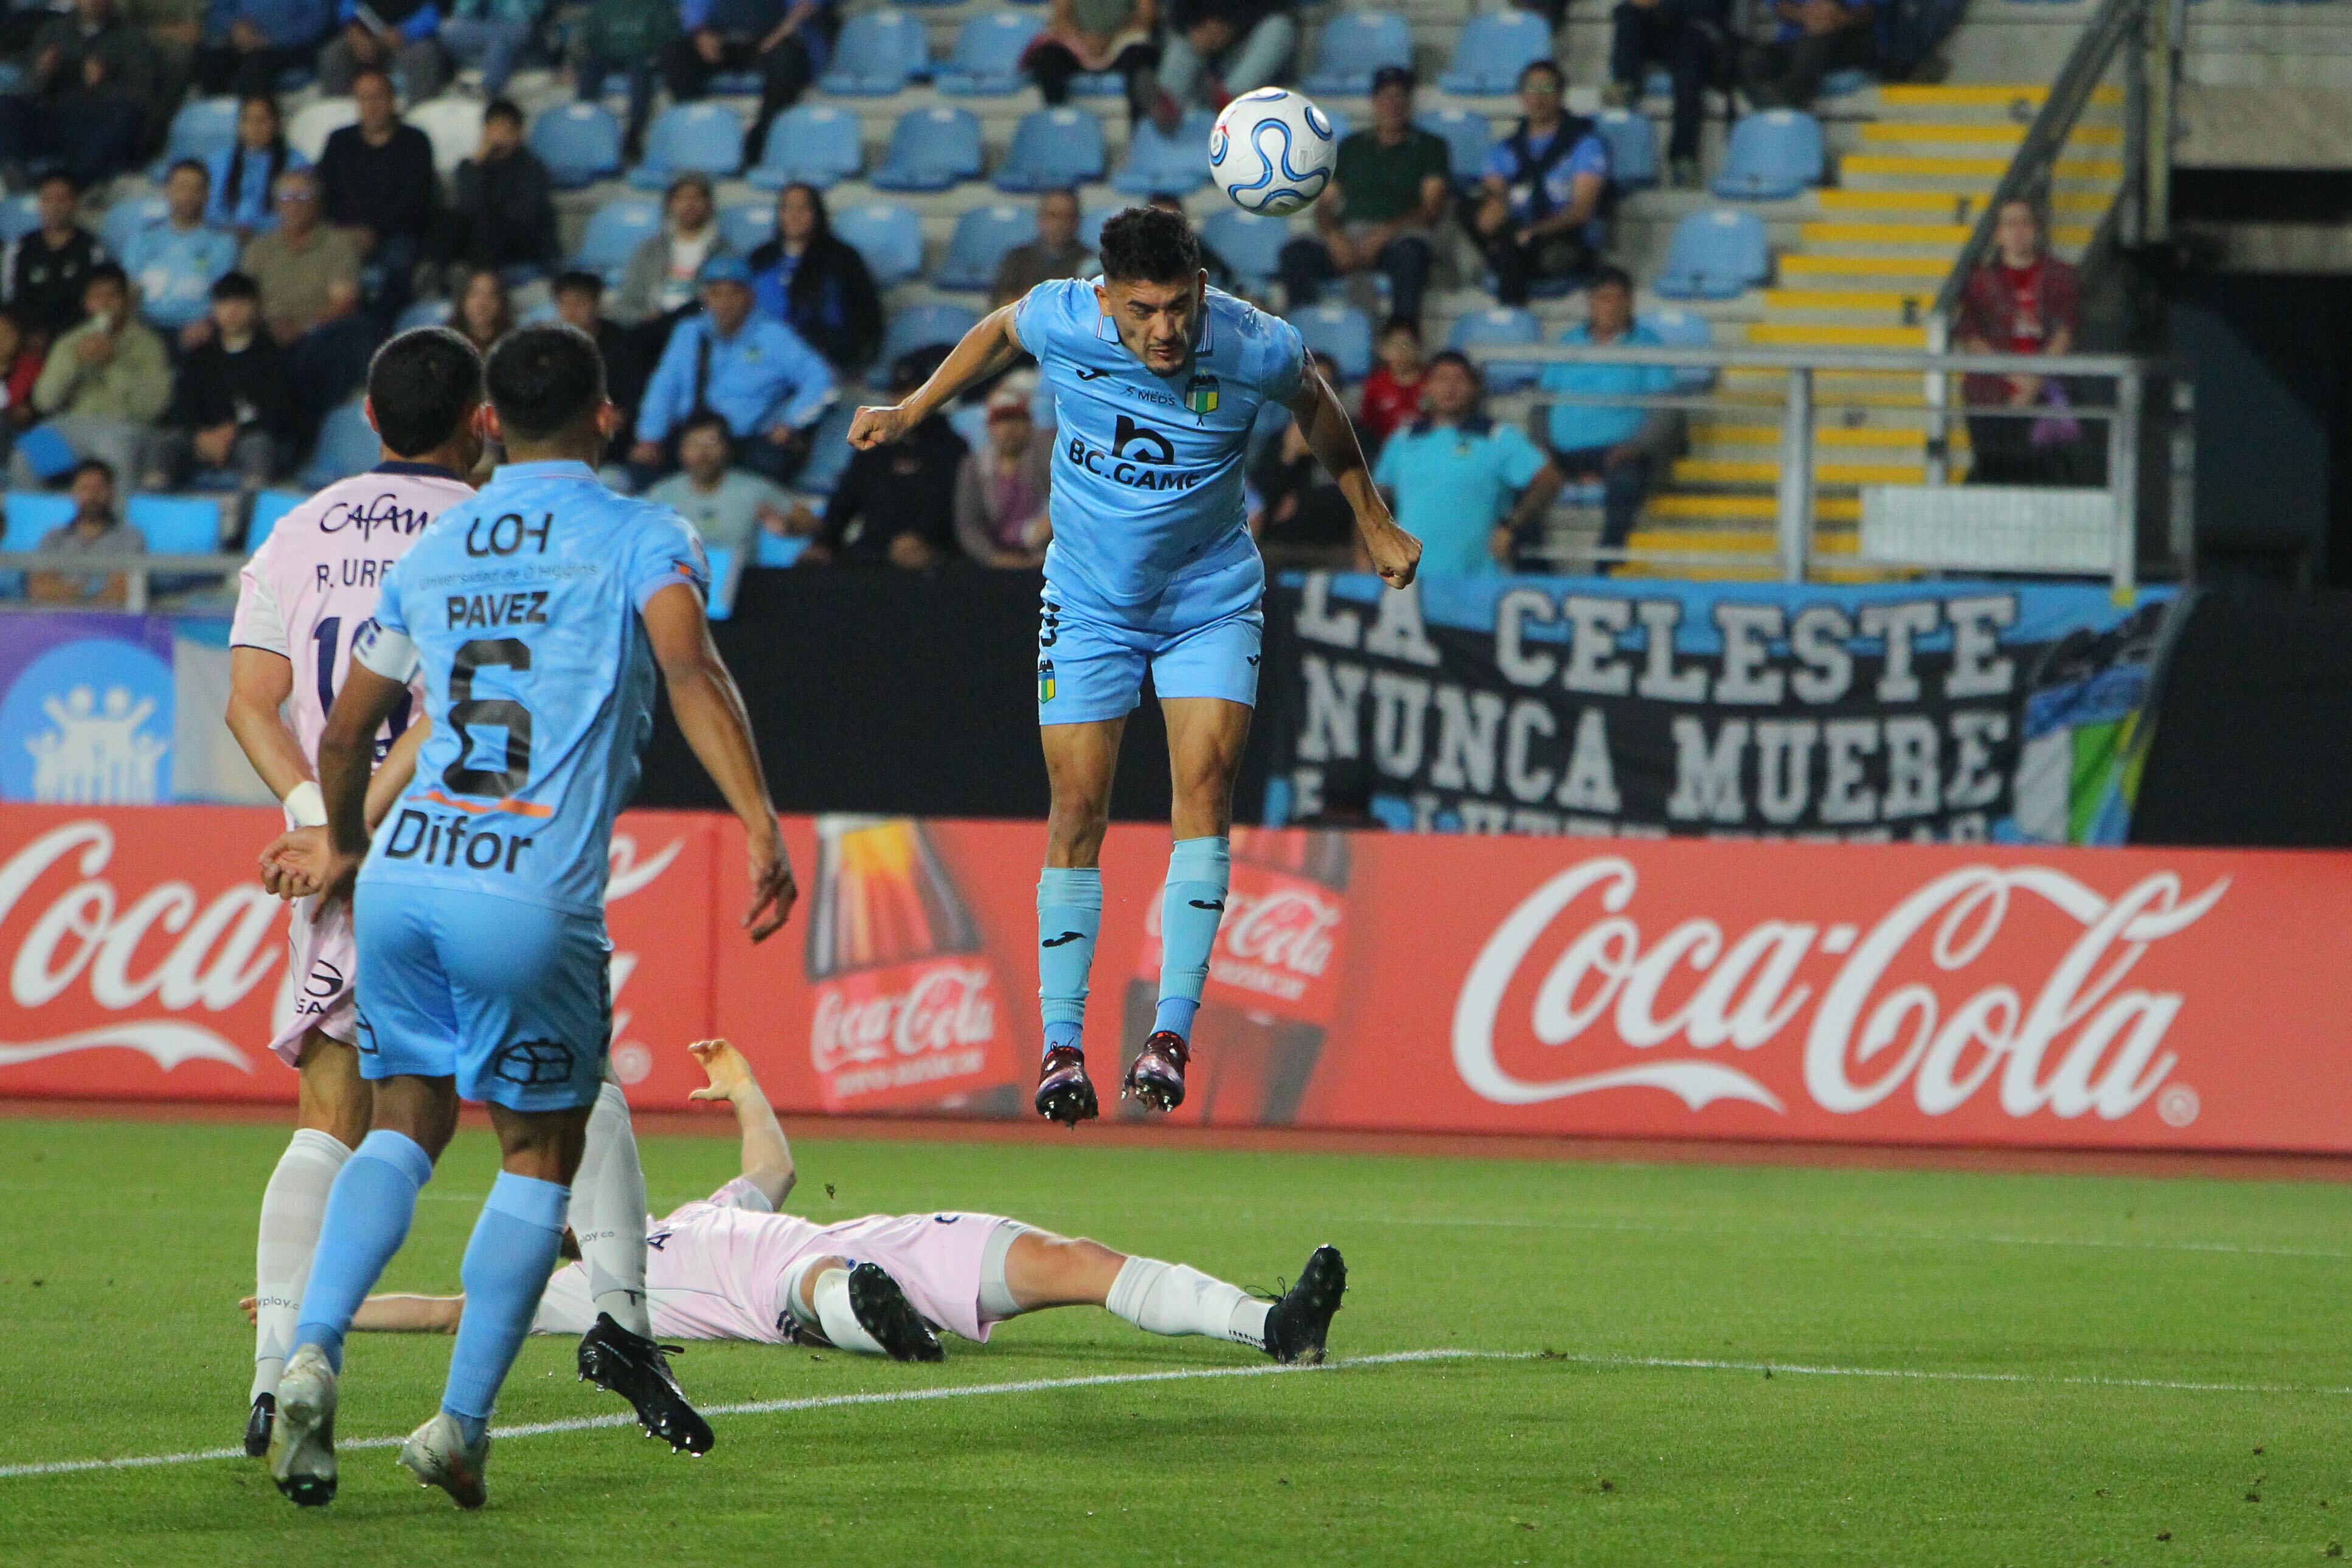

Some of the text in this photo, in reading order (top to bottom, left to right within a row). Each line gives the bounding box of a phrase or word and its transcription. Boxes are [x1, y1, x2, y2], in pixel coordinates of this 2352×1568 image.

[1137, 390, 1176, 406] MEDS
[1069, 437, 1200, 491] BC.GAME
[446, 591, 550, 631] PAVEZ
[1293, 569, 2016, 705] LA CELESTE
[442, 637, 532, 798] 6
[1296, 653, 1622, 814] NUNCA
[385, 808, 533, 873] Difor
[1451, 854, 2233, 1120] Coca-Cola
